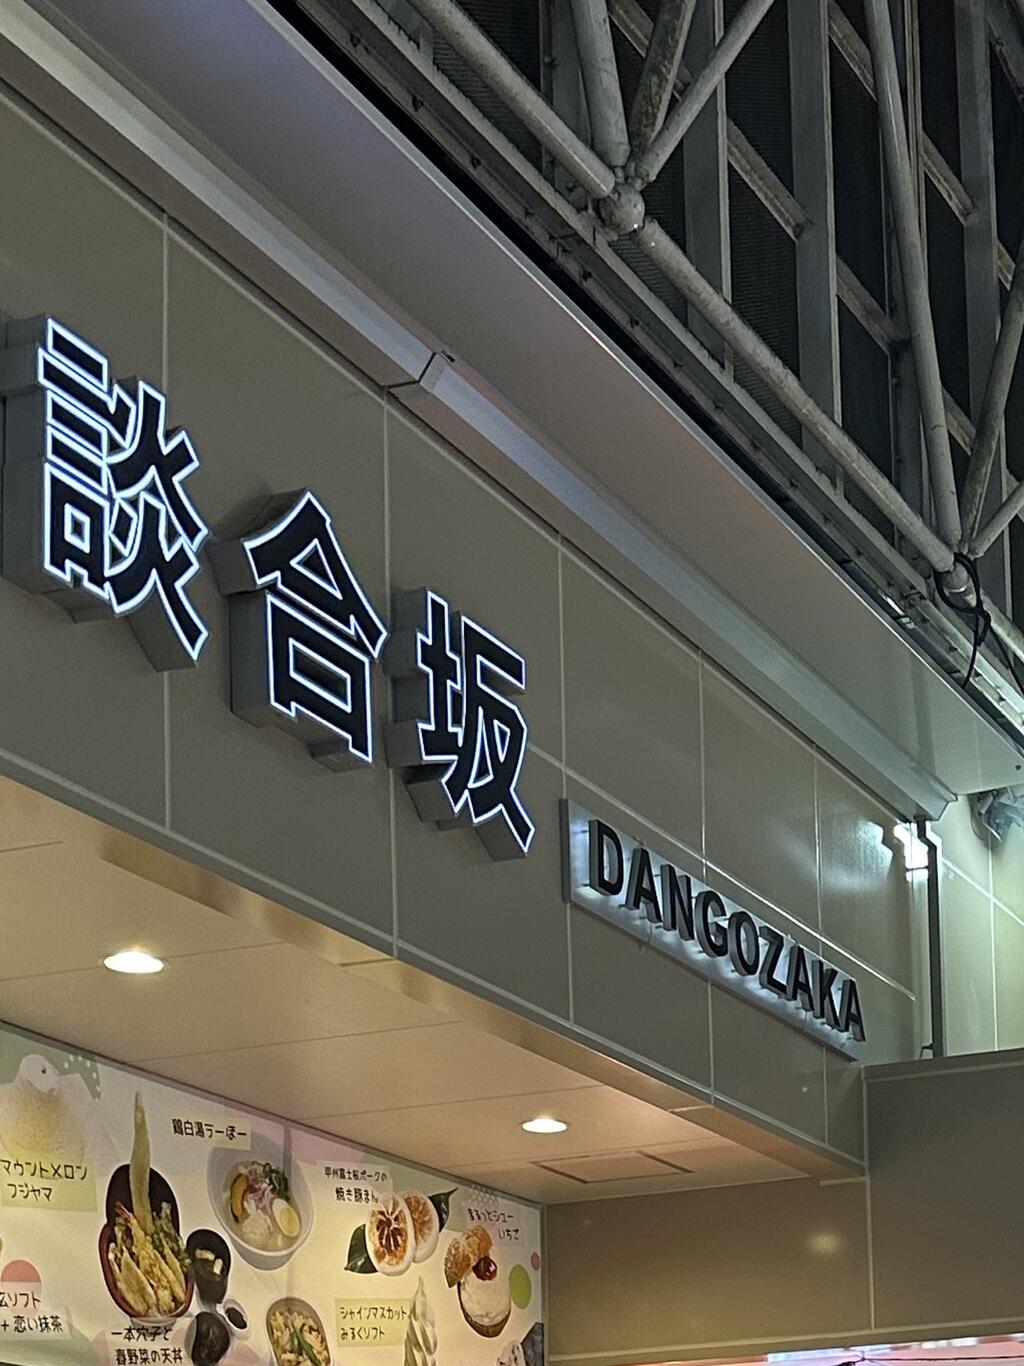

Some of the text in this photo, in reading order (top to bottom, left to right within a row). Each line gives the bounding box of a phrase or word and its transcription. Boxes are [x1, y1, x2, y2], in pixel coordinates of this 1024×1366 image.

[36, 316, 535, 855] 談合坂
[586, 819, 866, 1043] DANGOZAKA
[0, 1158, 88, 1181] マウントメロン
[6, 1183, 53, 1202] フジヤマ
[497, 1228, 520, 1241] いちご
[340, 1306, 408, 1321] シャインマスカット
[111, 1325, 173, 1342] 一本穴子と
[340, 1326, 386, 1341] みるくソフト
[115, 1347, 183, 1366] 春野菜の天丼
